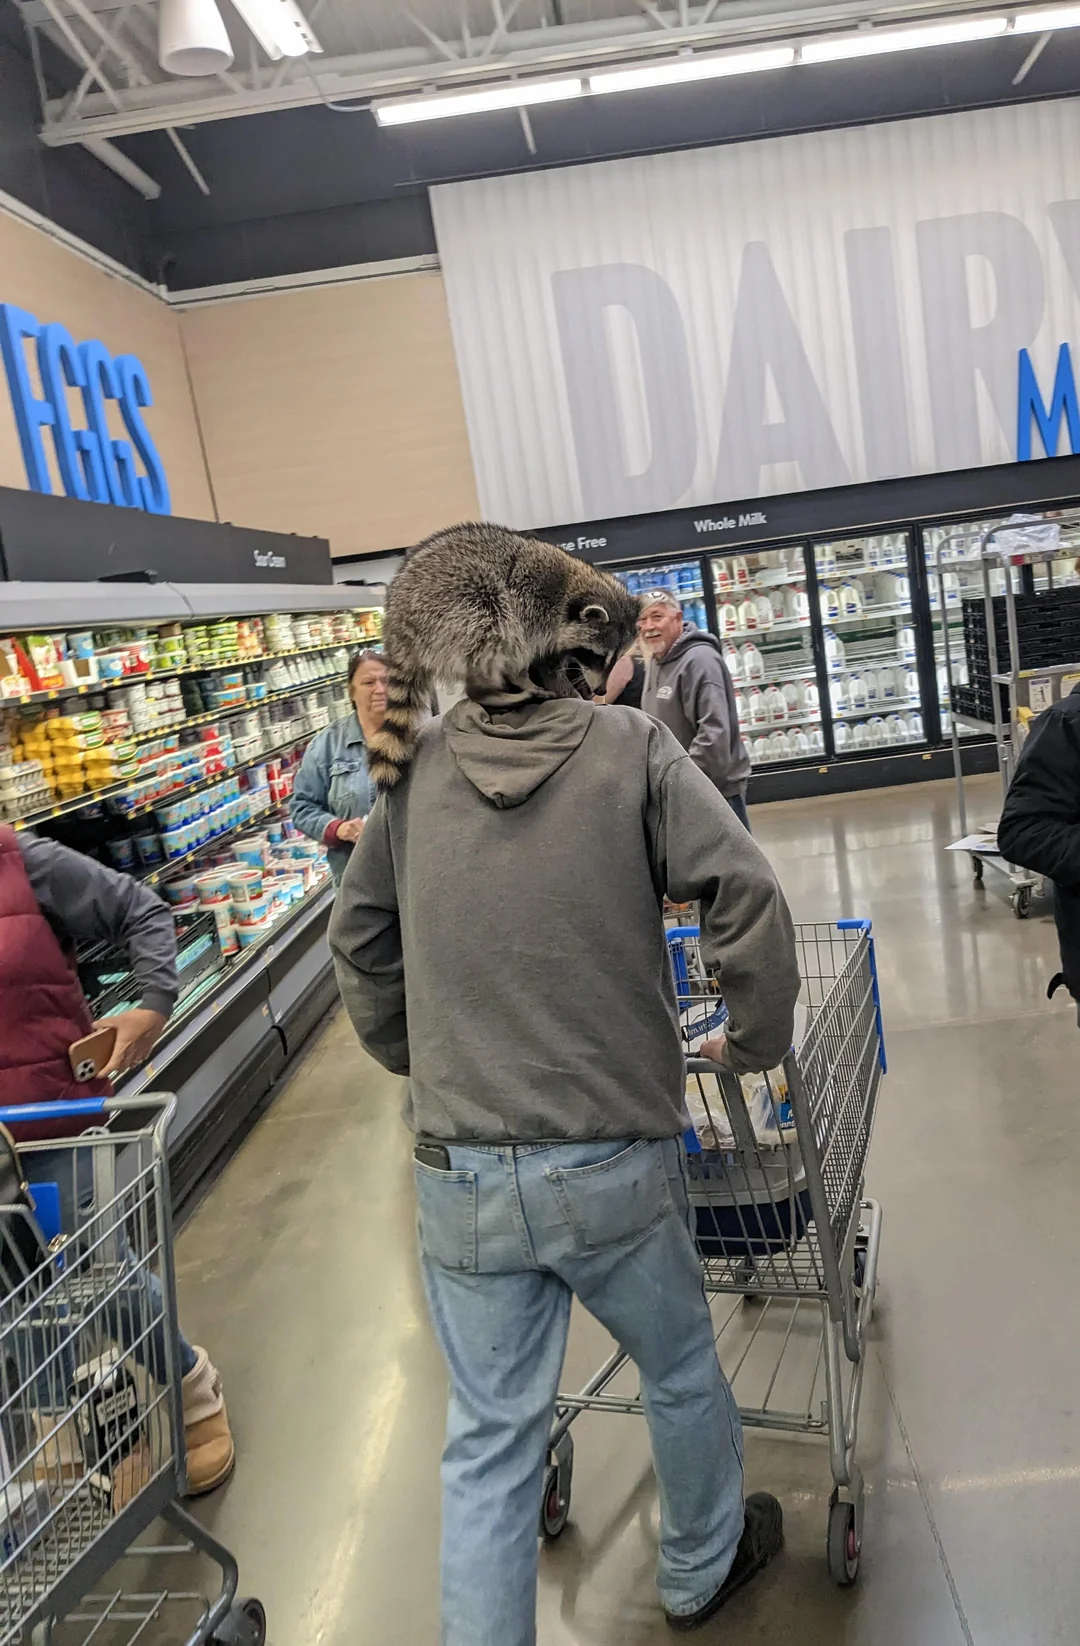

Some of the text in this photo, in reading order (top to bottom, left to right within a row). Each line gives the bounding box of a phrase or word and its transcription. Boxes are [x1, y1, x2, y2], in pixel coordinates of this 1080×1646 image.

[693, 511, 768, 533] Whole Milk
[577, 536, 608, 551] Free
